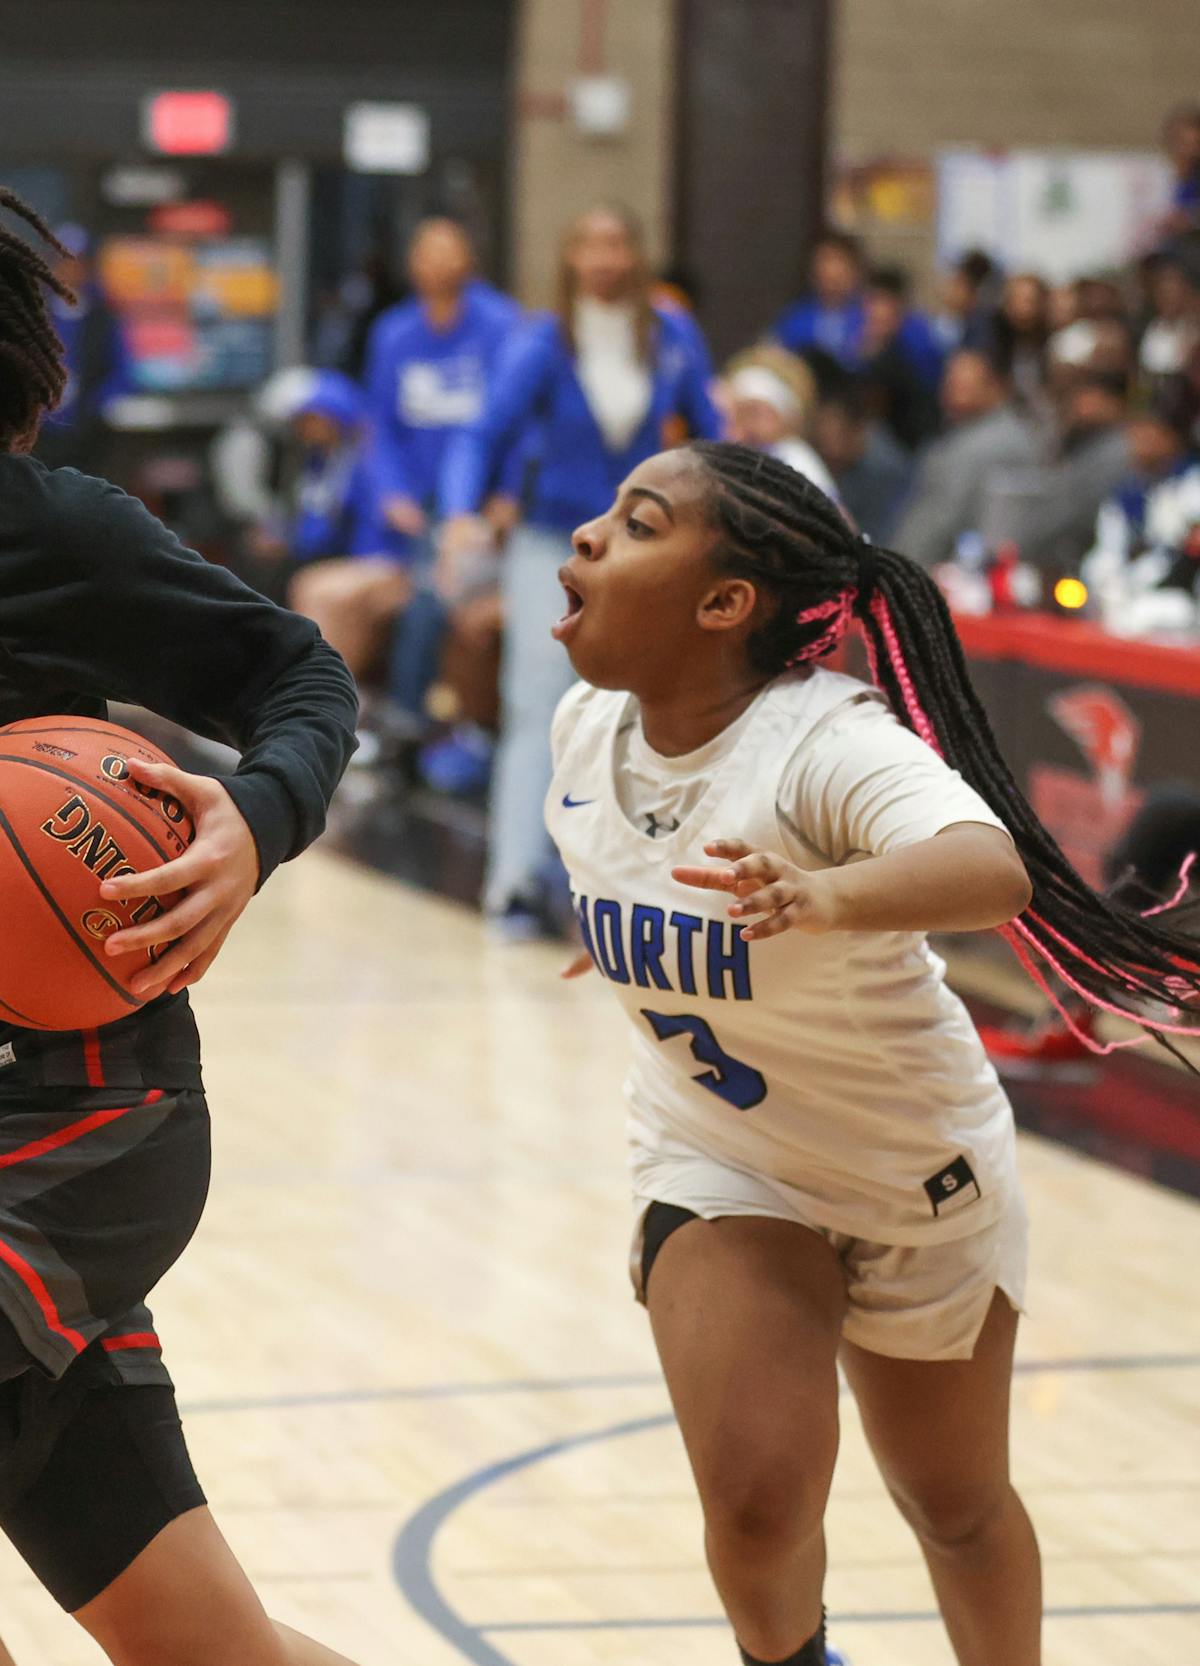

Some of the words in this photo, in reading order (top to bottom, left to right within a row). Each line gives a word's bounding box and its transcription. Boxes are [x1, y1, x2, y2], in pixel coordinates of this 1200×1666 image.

[572, 891, 753, 1001] NORTH
[640, 1008, 768, 1111] 3
[942, 1174, 958, 1192] S
